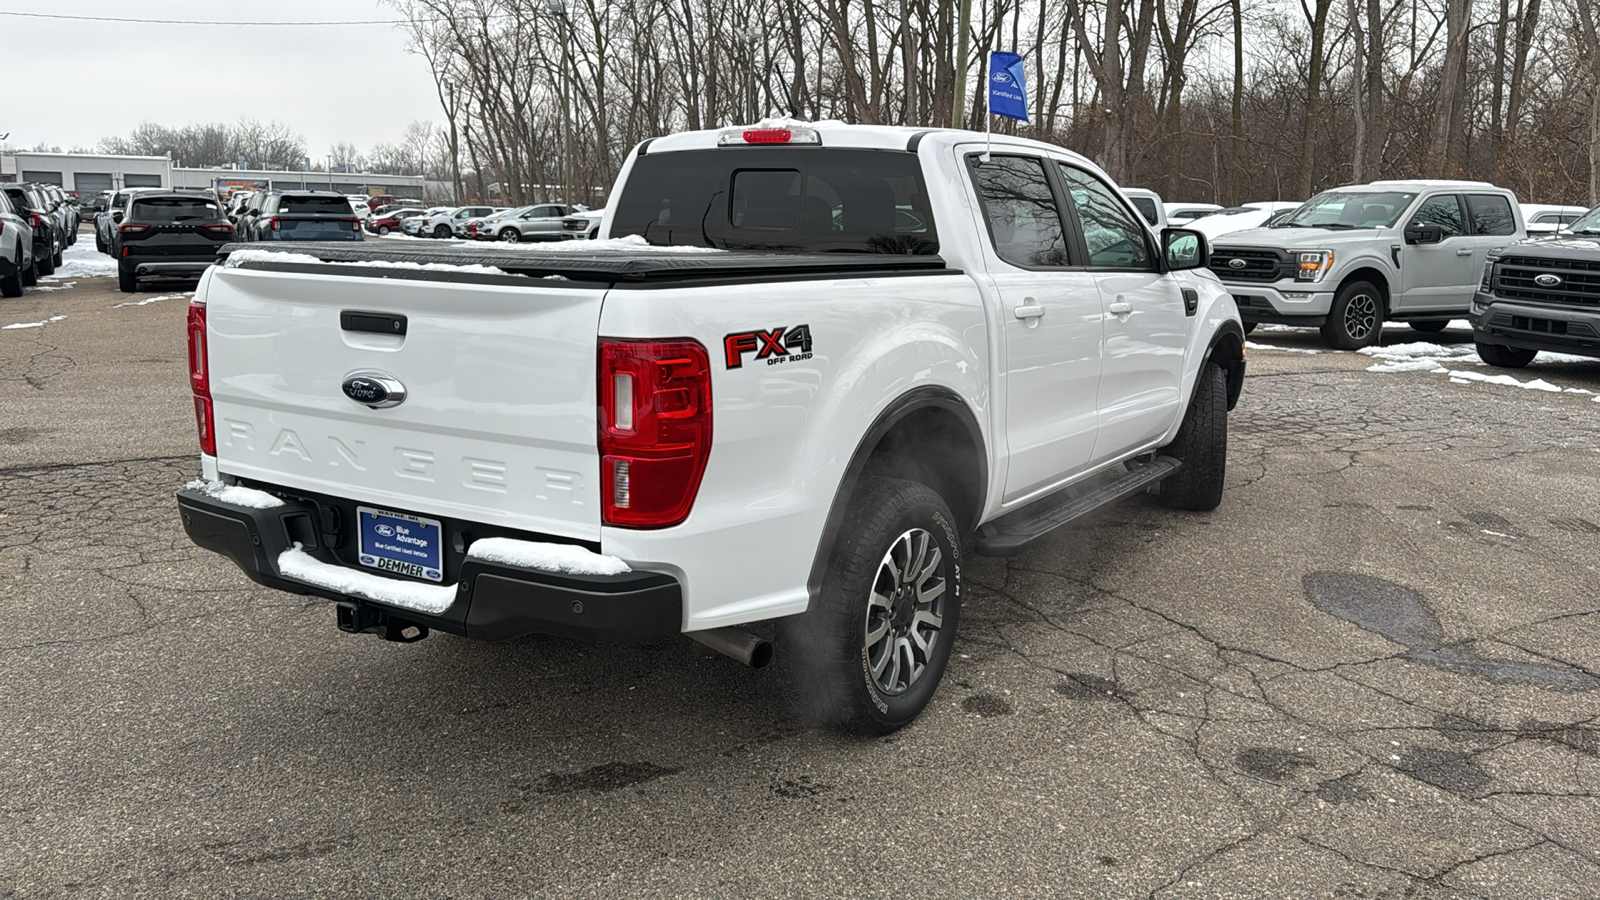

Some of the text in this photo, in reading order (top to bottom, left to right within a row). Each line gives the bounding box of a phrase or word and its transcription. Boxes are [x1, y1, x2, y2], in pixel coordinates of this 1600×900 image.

[723, 324, 813, 371] FX4
[767, 352, 813, 366] OFF ROAD
[349, 380, 377, 399] Ford
[223, 417, 585, 506] RANGER
[396, 525, 410, 535] Blue
[374, 541, 428, 558] Blue Certified Used Vehicle
[396, 534, 428, 547] Advantage
[377, 558, 424, 577] DEMMER
